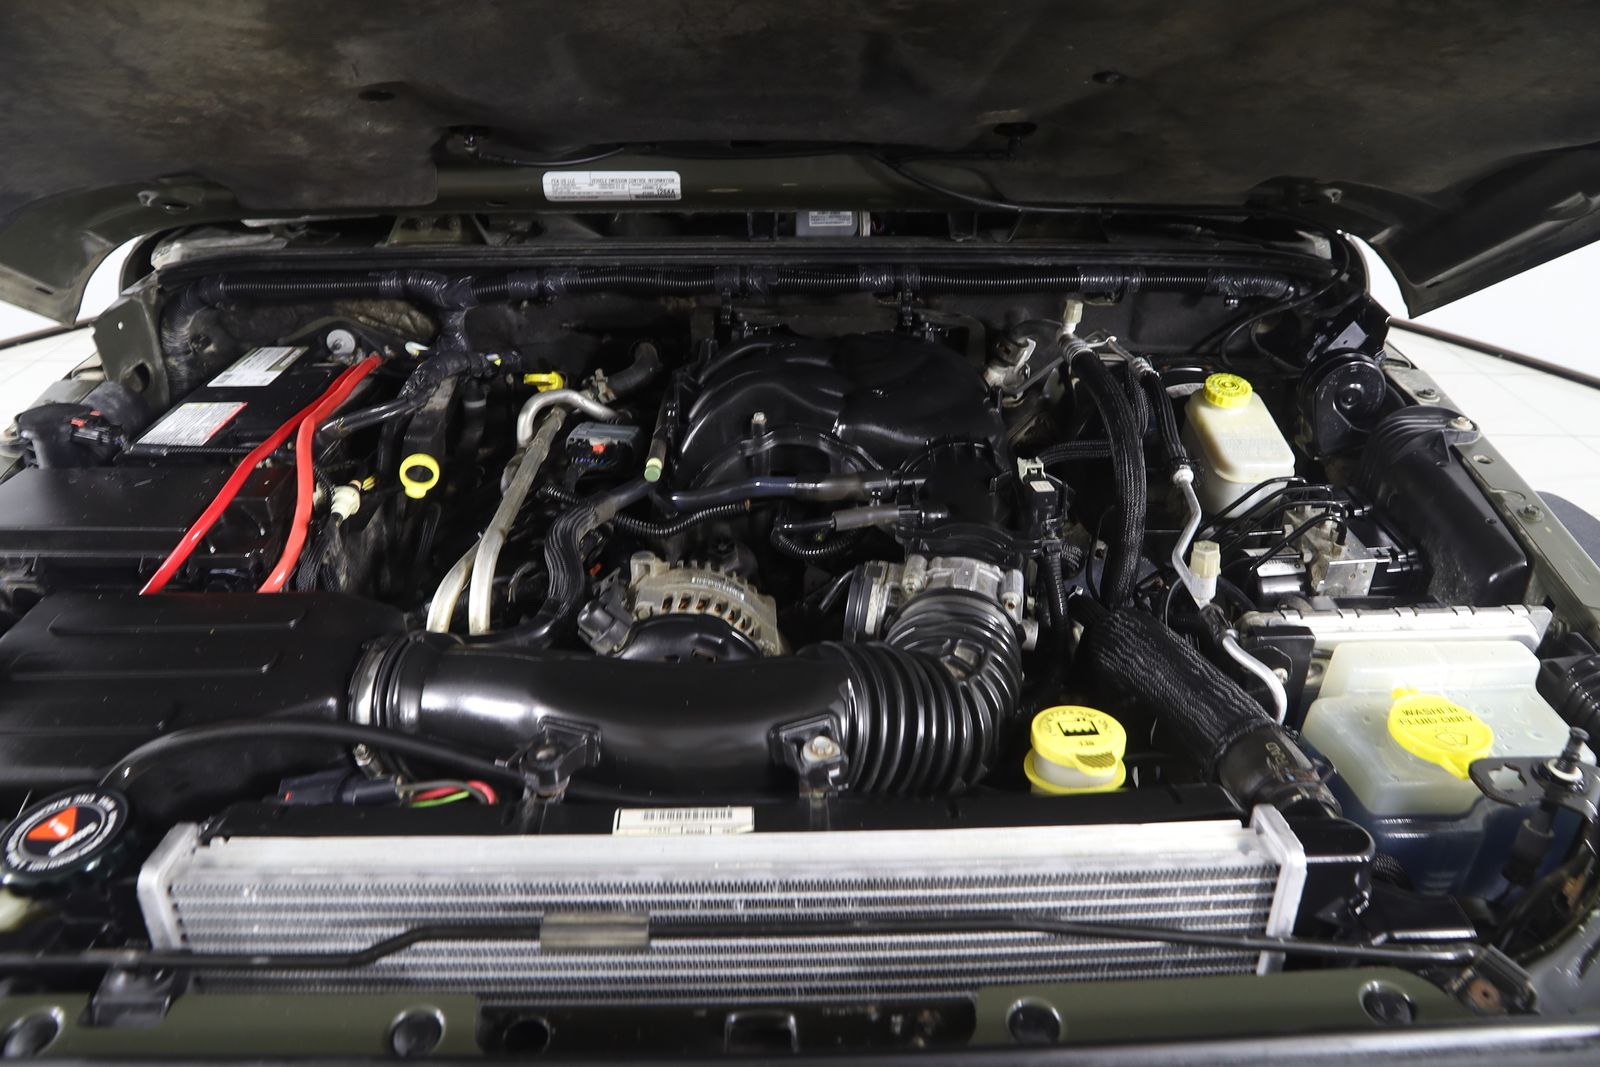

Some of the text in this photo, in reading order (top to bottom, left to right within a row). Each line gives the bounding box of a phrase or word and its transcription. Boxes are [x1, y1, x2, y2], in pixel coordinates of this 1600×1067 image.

[1402, 706, 1458, 716] WASHER
[1399, 714, 1473, 726] FLUID ONLY
